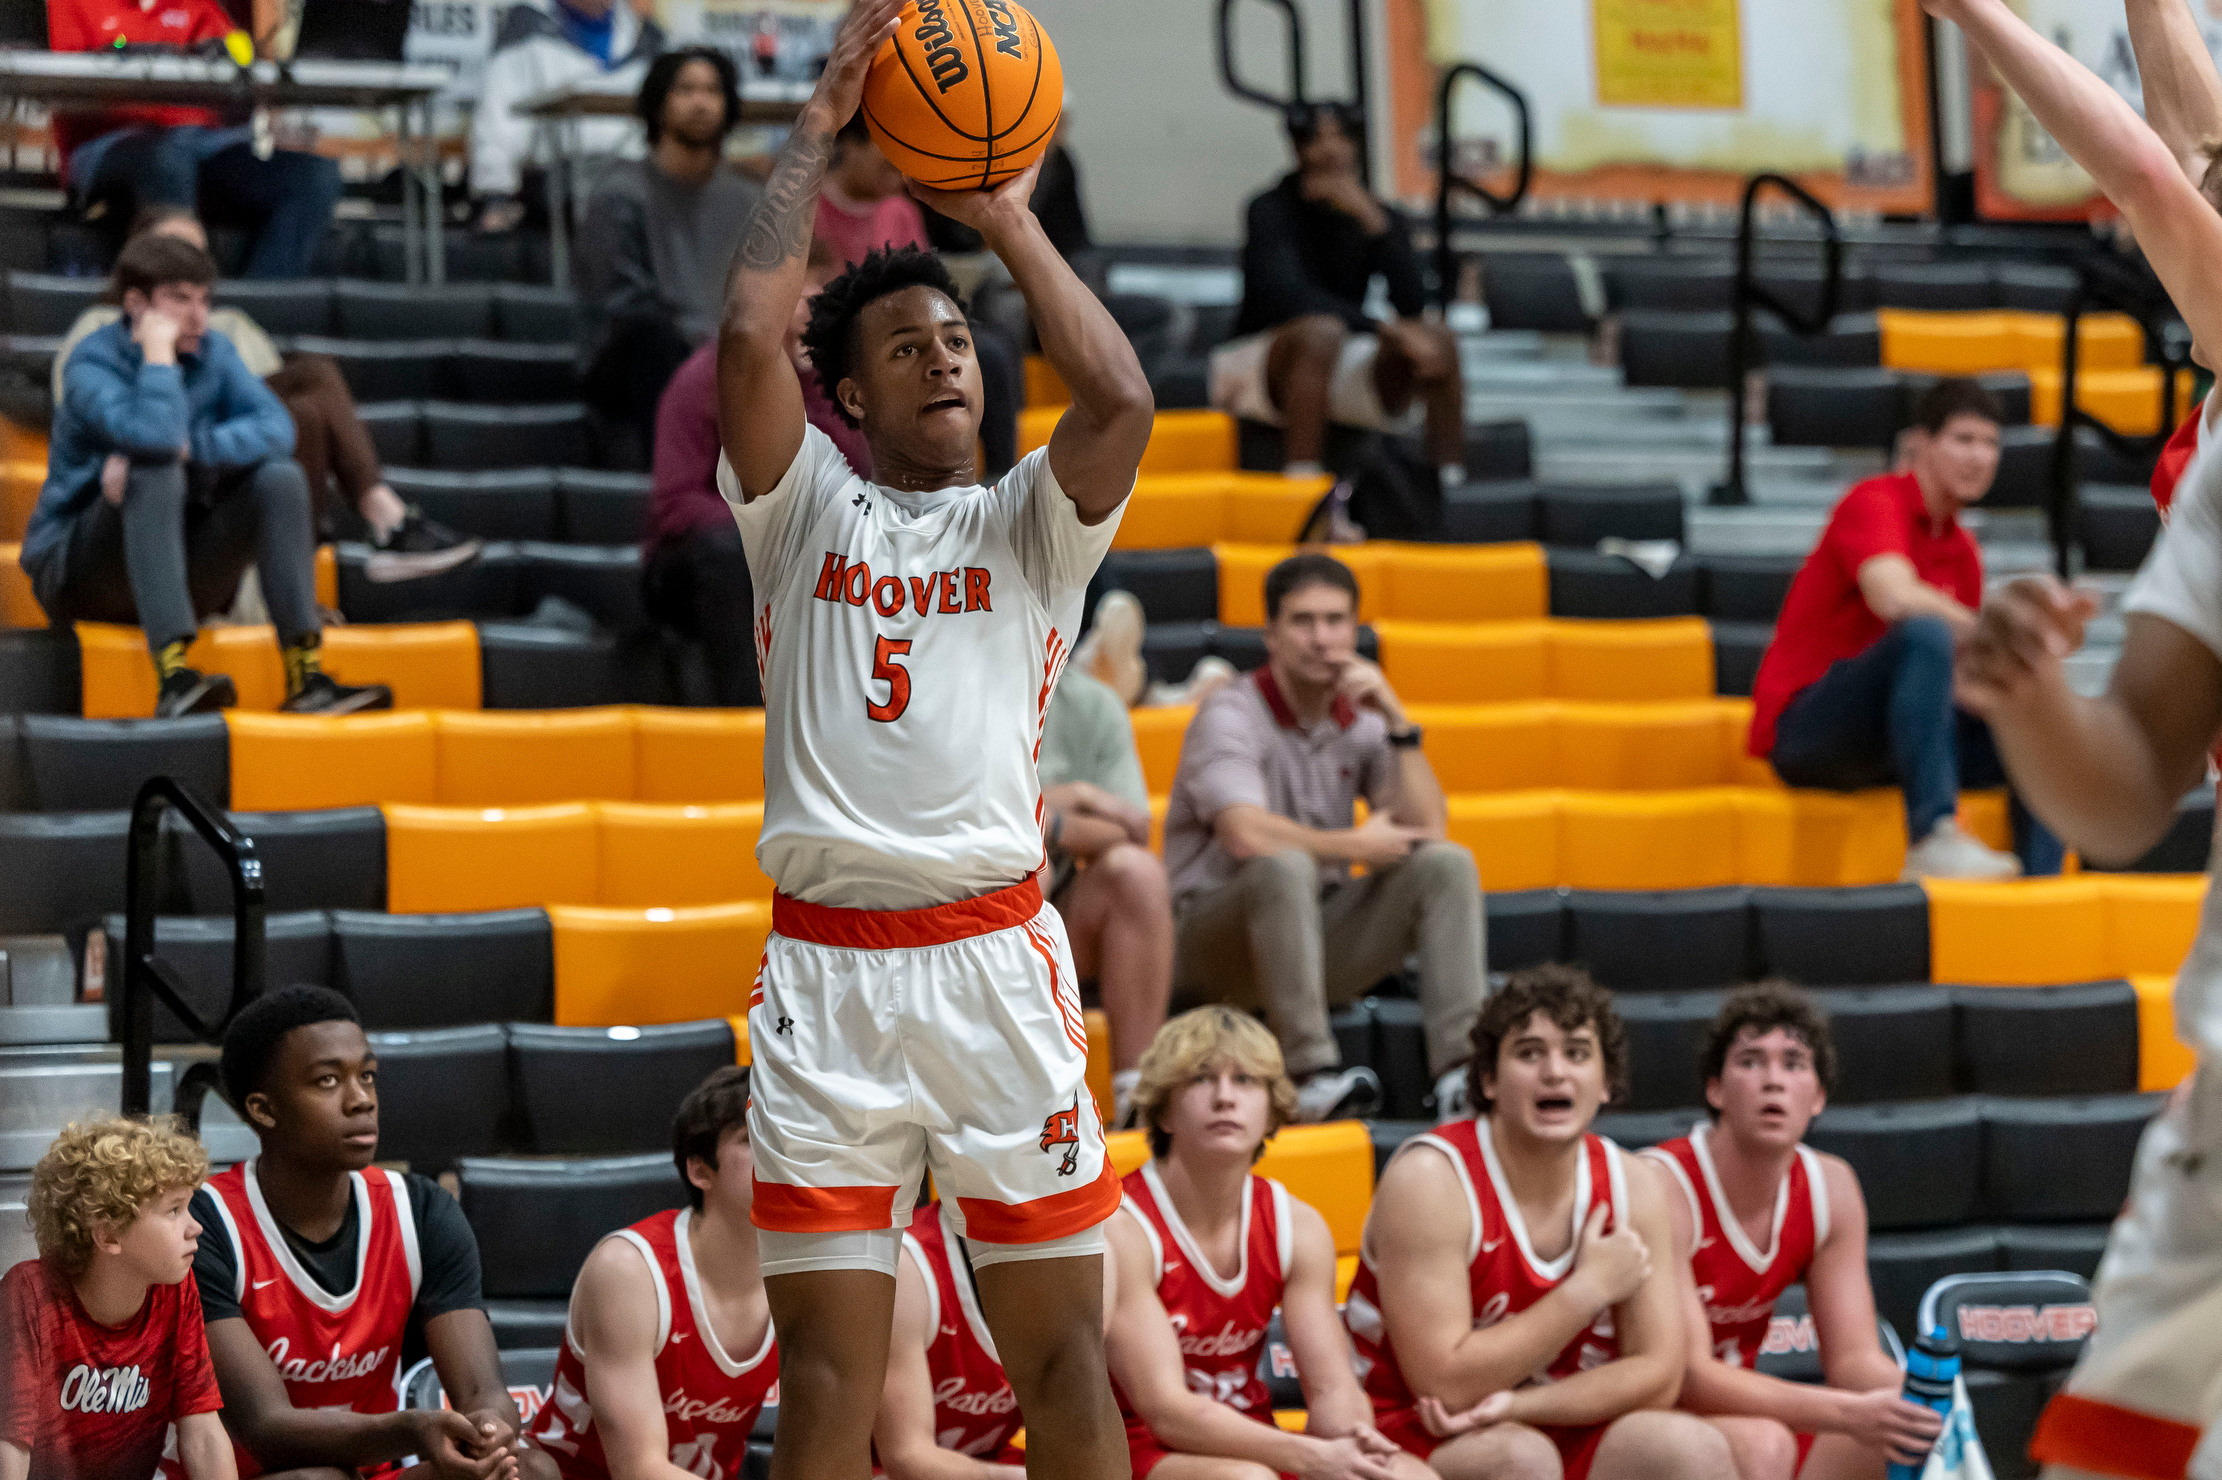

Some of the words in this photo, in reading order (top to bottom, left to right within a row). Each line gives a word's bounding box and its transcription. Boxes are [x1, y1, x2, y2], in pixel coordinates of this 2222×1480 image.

[813, 551, 993, 618] HOOVER
[865, 633, 913, 723] 5
[60, 1363, 108, 1414] Ole
